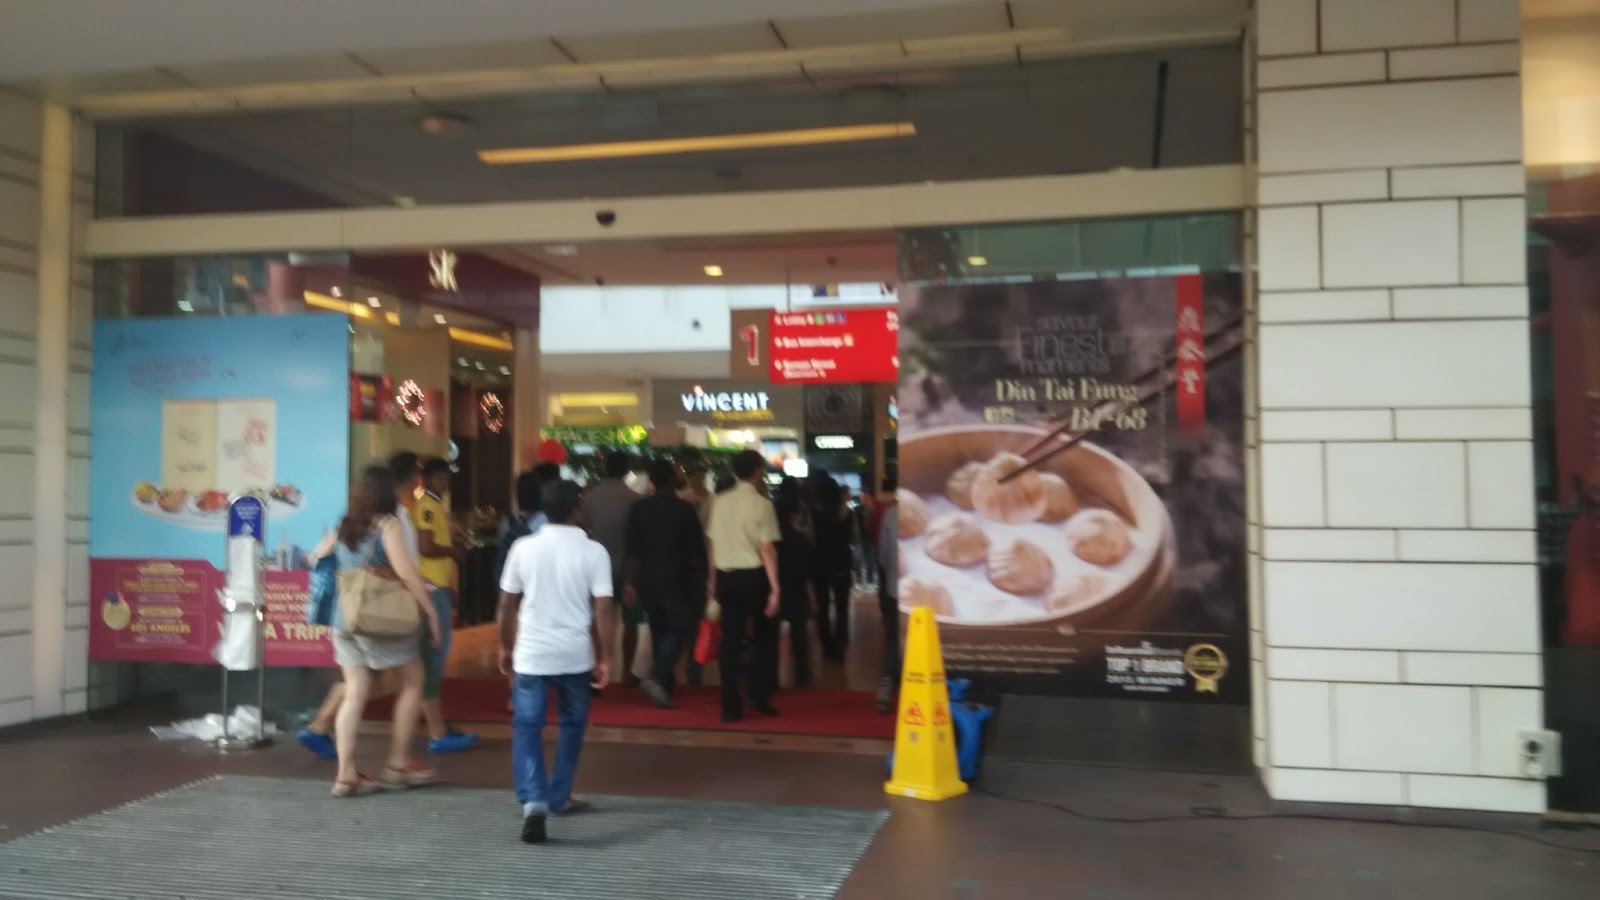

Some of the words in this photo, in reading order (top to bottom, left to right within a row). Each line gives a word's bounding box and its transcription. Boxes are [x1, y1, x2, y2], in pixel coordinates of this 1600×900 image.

[739, 324, 760, 366] 1
[681, 387, 770, 412] VINCENT
[996, 378, 1037, 401] Din
[1039, 377, 1076, 401] Tai
[1080, 376, 1140, 404] Fung
